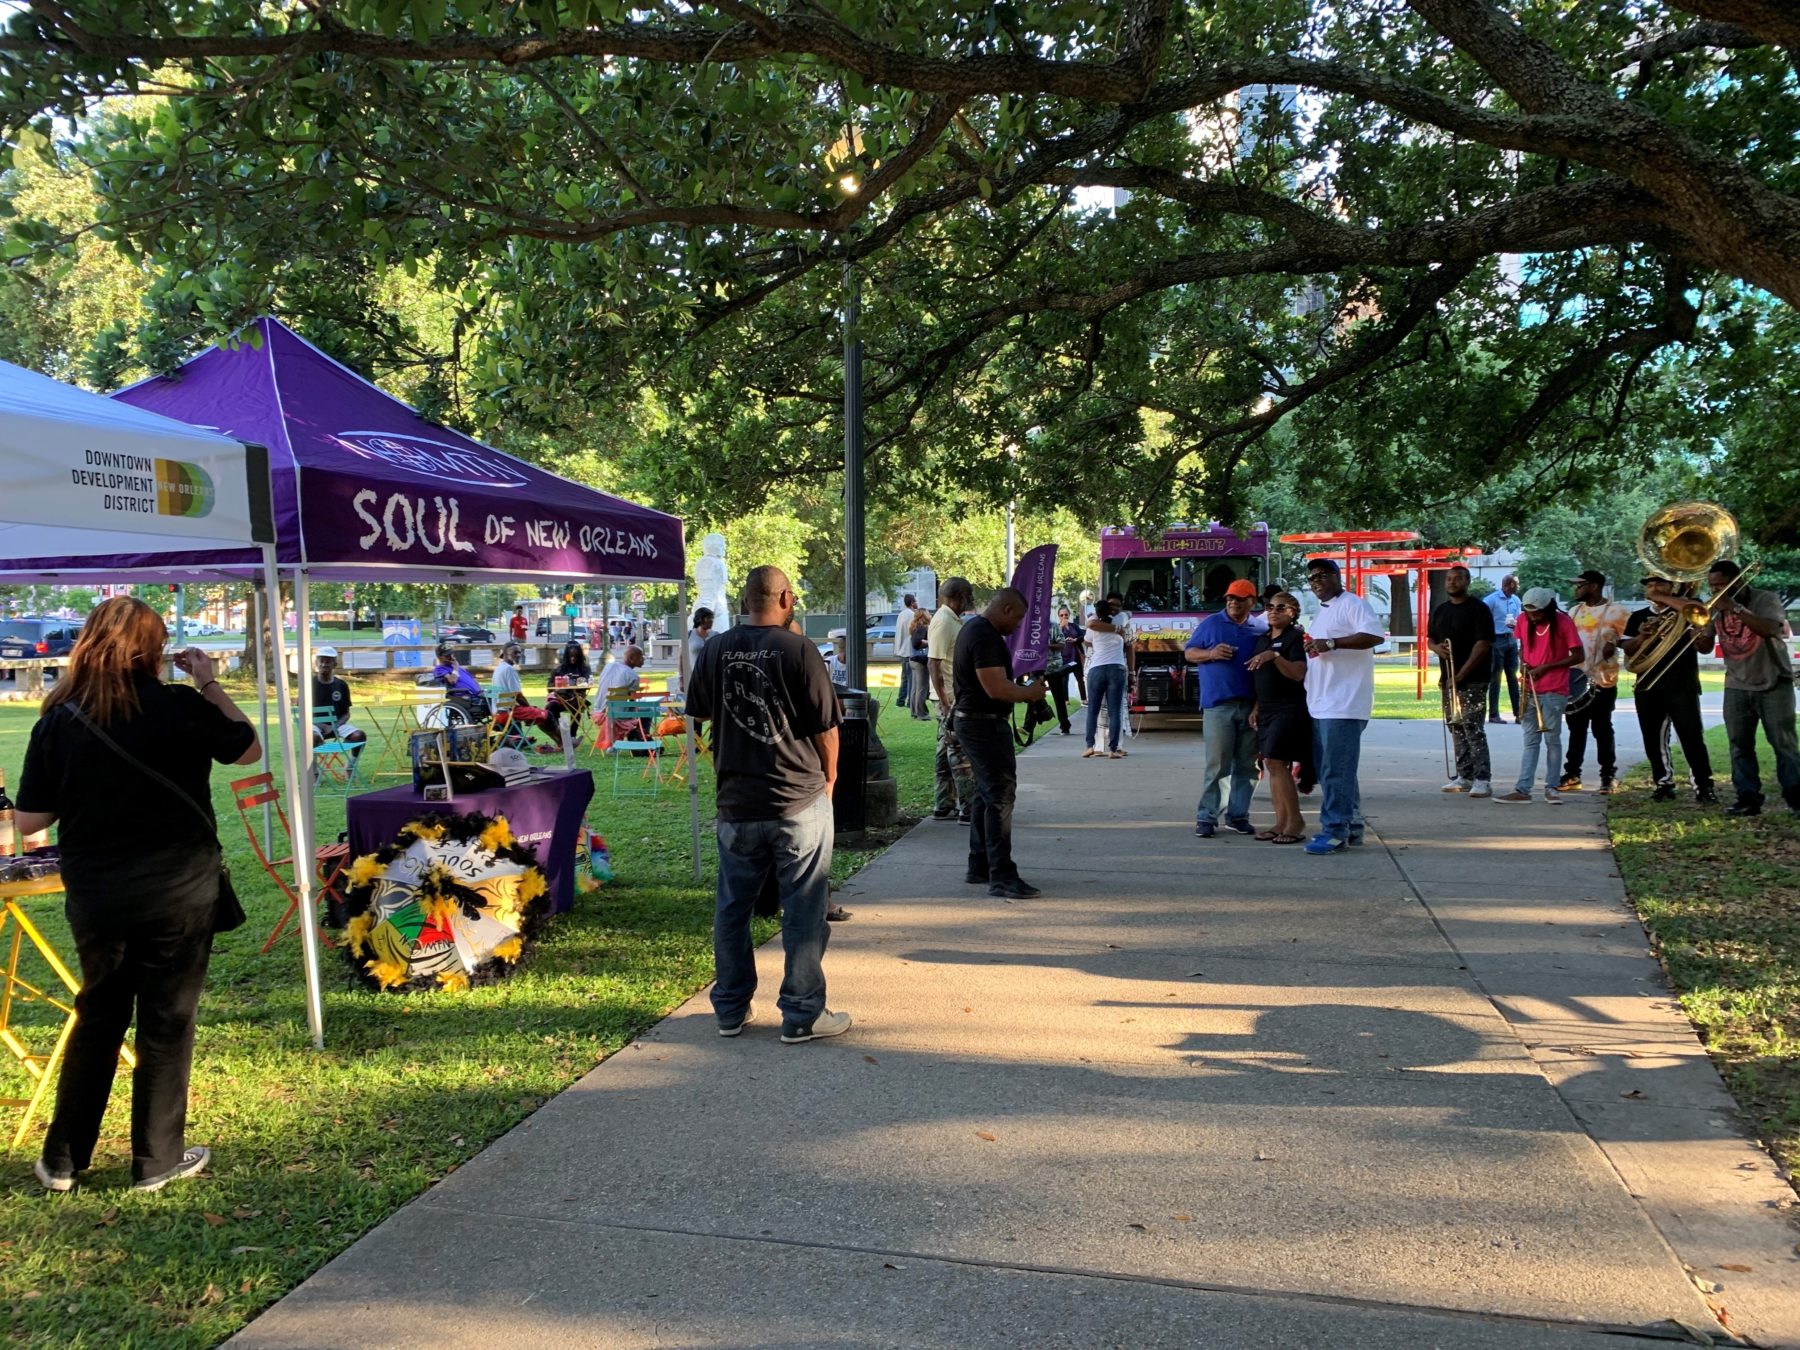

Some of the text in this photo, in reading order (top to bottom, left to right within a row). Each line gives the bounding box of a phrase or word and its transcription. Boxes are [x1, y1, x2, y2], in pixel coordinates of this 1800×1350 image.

[85, 449, 152, 472] DOWNTOWN
[72, 469, 153, 493] DEVELOPMENT
[157, 481, 215, 497] NEW ORLEANS
[104, 494, 155, 514] DISTRICT
[353, 488, 658, 559] SOUL OF NEW ORLEANS
[1038, 553, 1046, 584] ORLEANS
[1034, 604, 1041, 614] OF
[1030, 615, 1042, 645] SOUL
[721, 651, 757, 660] FLAVOR
[747, 716, 756, 726] 5
[437, 854, 483, 879] SOUL
